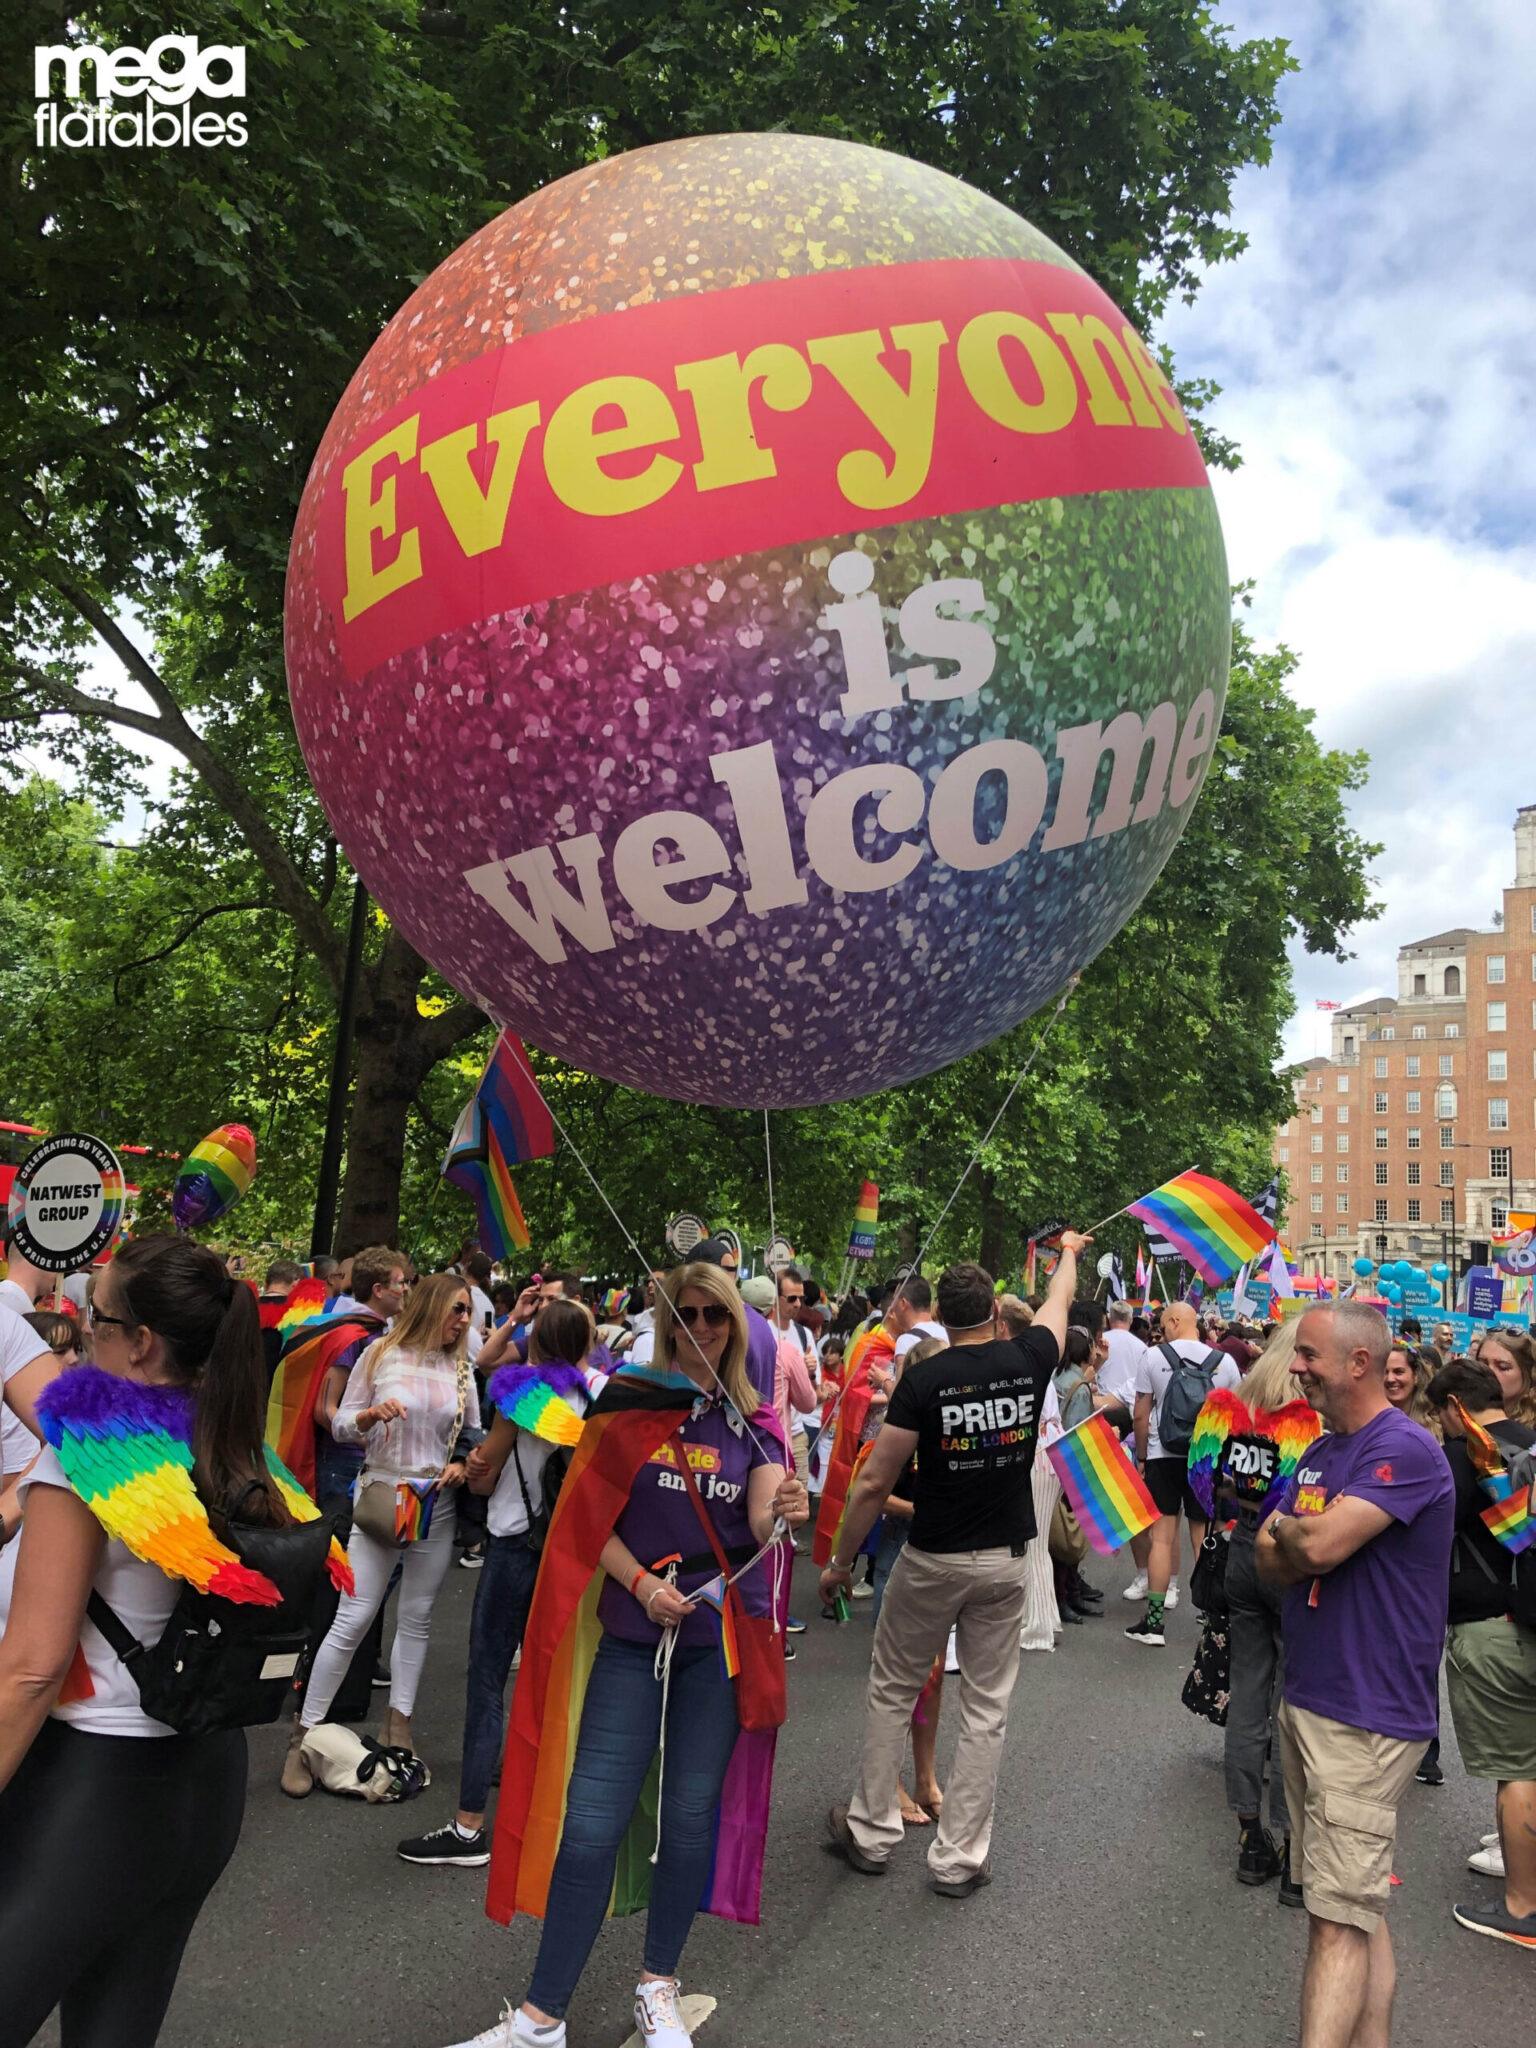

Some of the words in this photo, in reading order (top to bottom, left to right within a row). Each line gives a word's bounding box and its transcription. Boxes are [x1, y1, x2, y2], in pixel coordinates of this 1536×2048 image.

[826, 550, 998, 717] is
[462, 688, 1214, 965] welcome
[21, 1138, 77, 1179] CELEBRATING
[78, 1140, 90, 1151] 50
[91, 1146, 114, 1175] YEARS
[30, 1184, 101, 1201] NATWEST
[38, 1206, 89, 1221] GROUP
[16, 1232, 25, 1246] OF
[25, 1248, 52, 1268] PRIDE
[56, 1260, 66, 1268] IN
[70, 1249, 90, 1265] THE
[989, 1377, 1033, 1391] @UEL_NEWS
[941, 1394, 1035, 1435] PRIDE
[941, 1436, 978, 1451] EAST
[982, 1426, 1033, 1448] LONDON
[650, 1443, 715, 1468] Prde
[706, 1474, 741, 1503] joy
